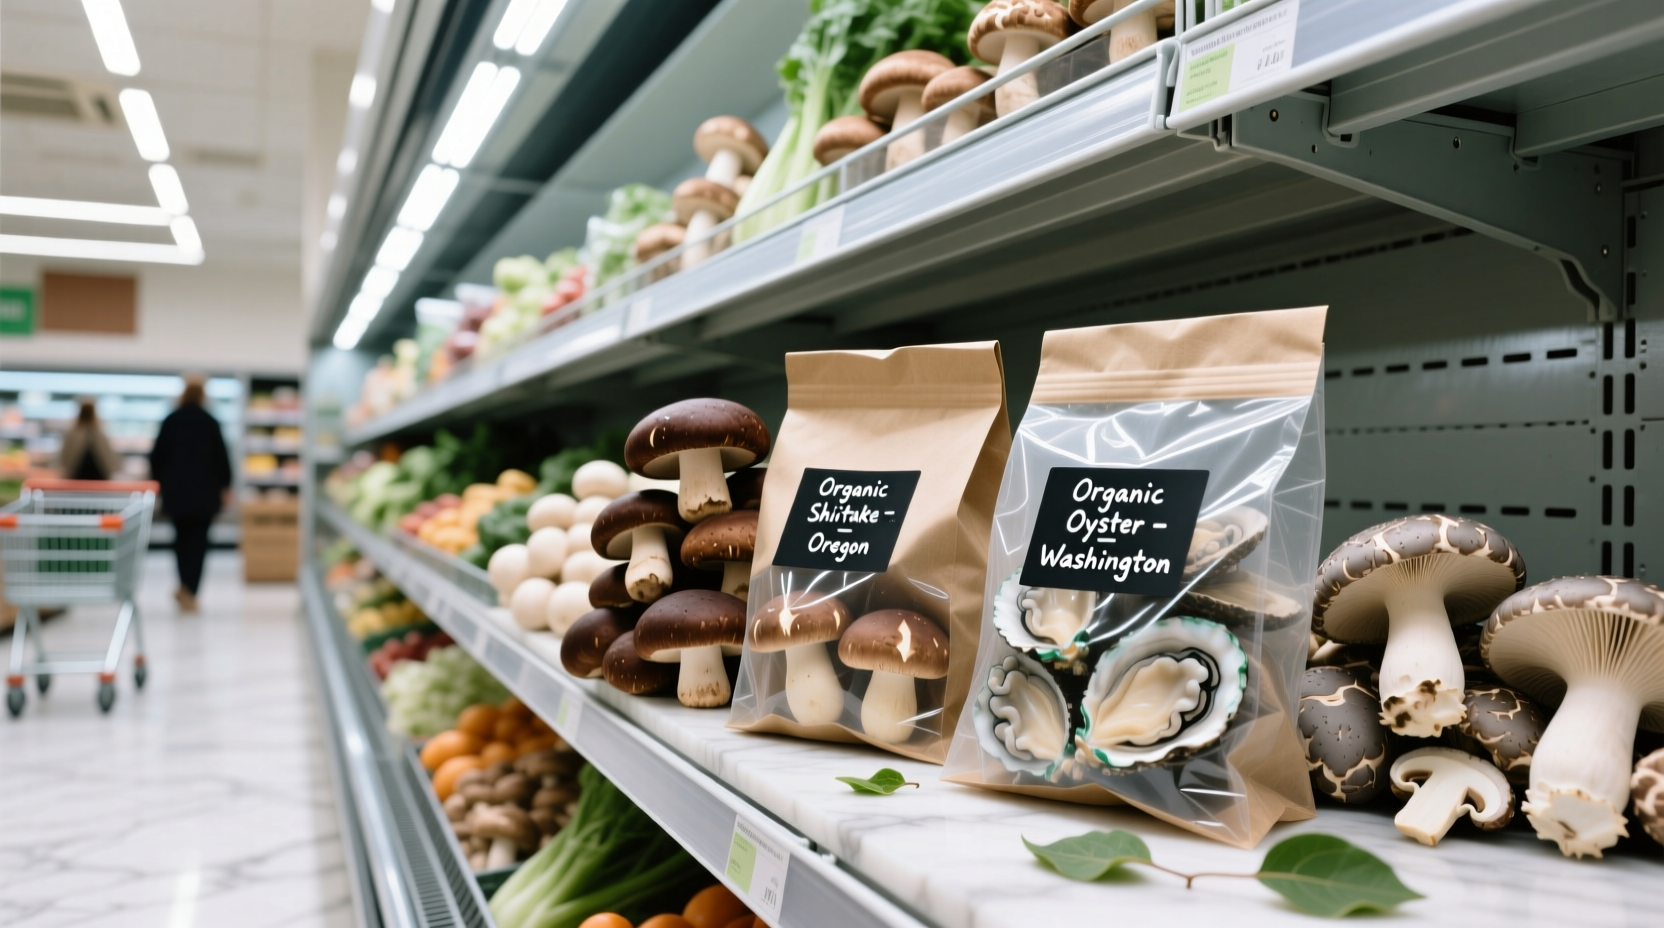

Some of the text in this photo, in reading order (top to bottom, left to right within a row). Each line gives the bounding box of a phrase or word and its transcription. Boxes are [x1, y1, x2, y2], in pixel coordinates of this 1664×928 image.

[819, 476, 889, 504] Organic
[1072, 477, 1165, 514] Organic
[1066, 508, 1146, 543] Oyster
[807, 531, 870, 563] Oregon
[1040, 543, 1171, 583] Washington
